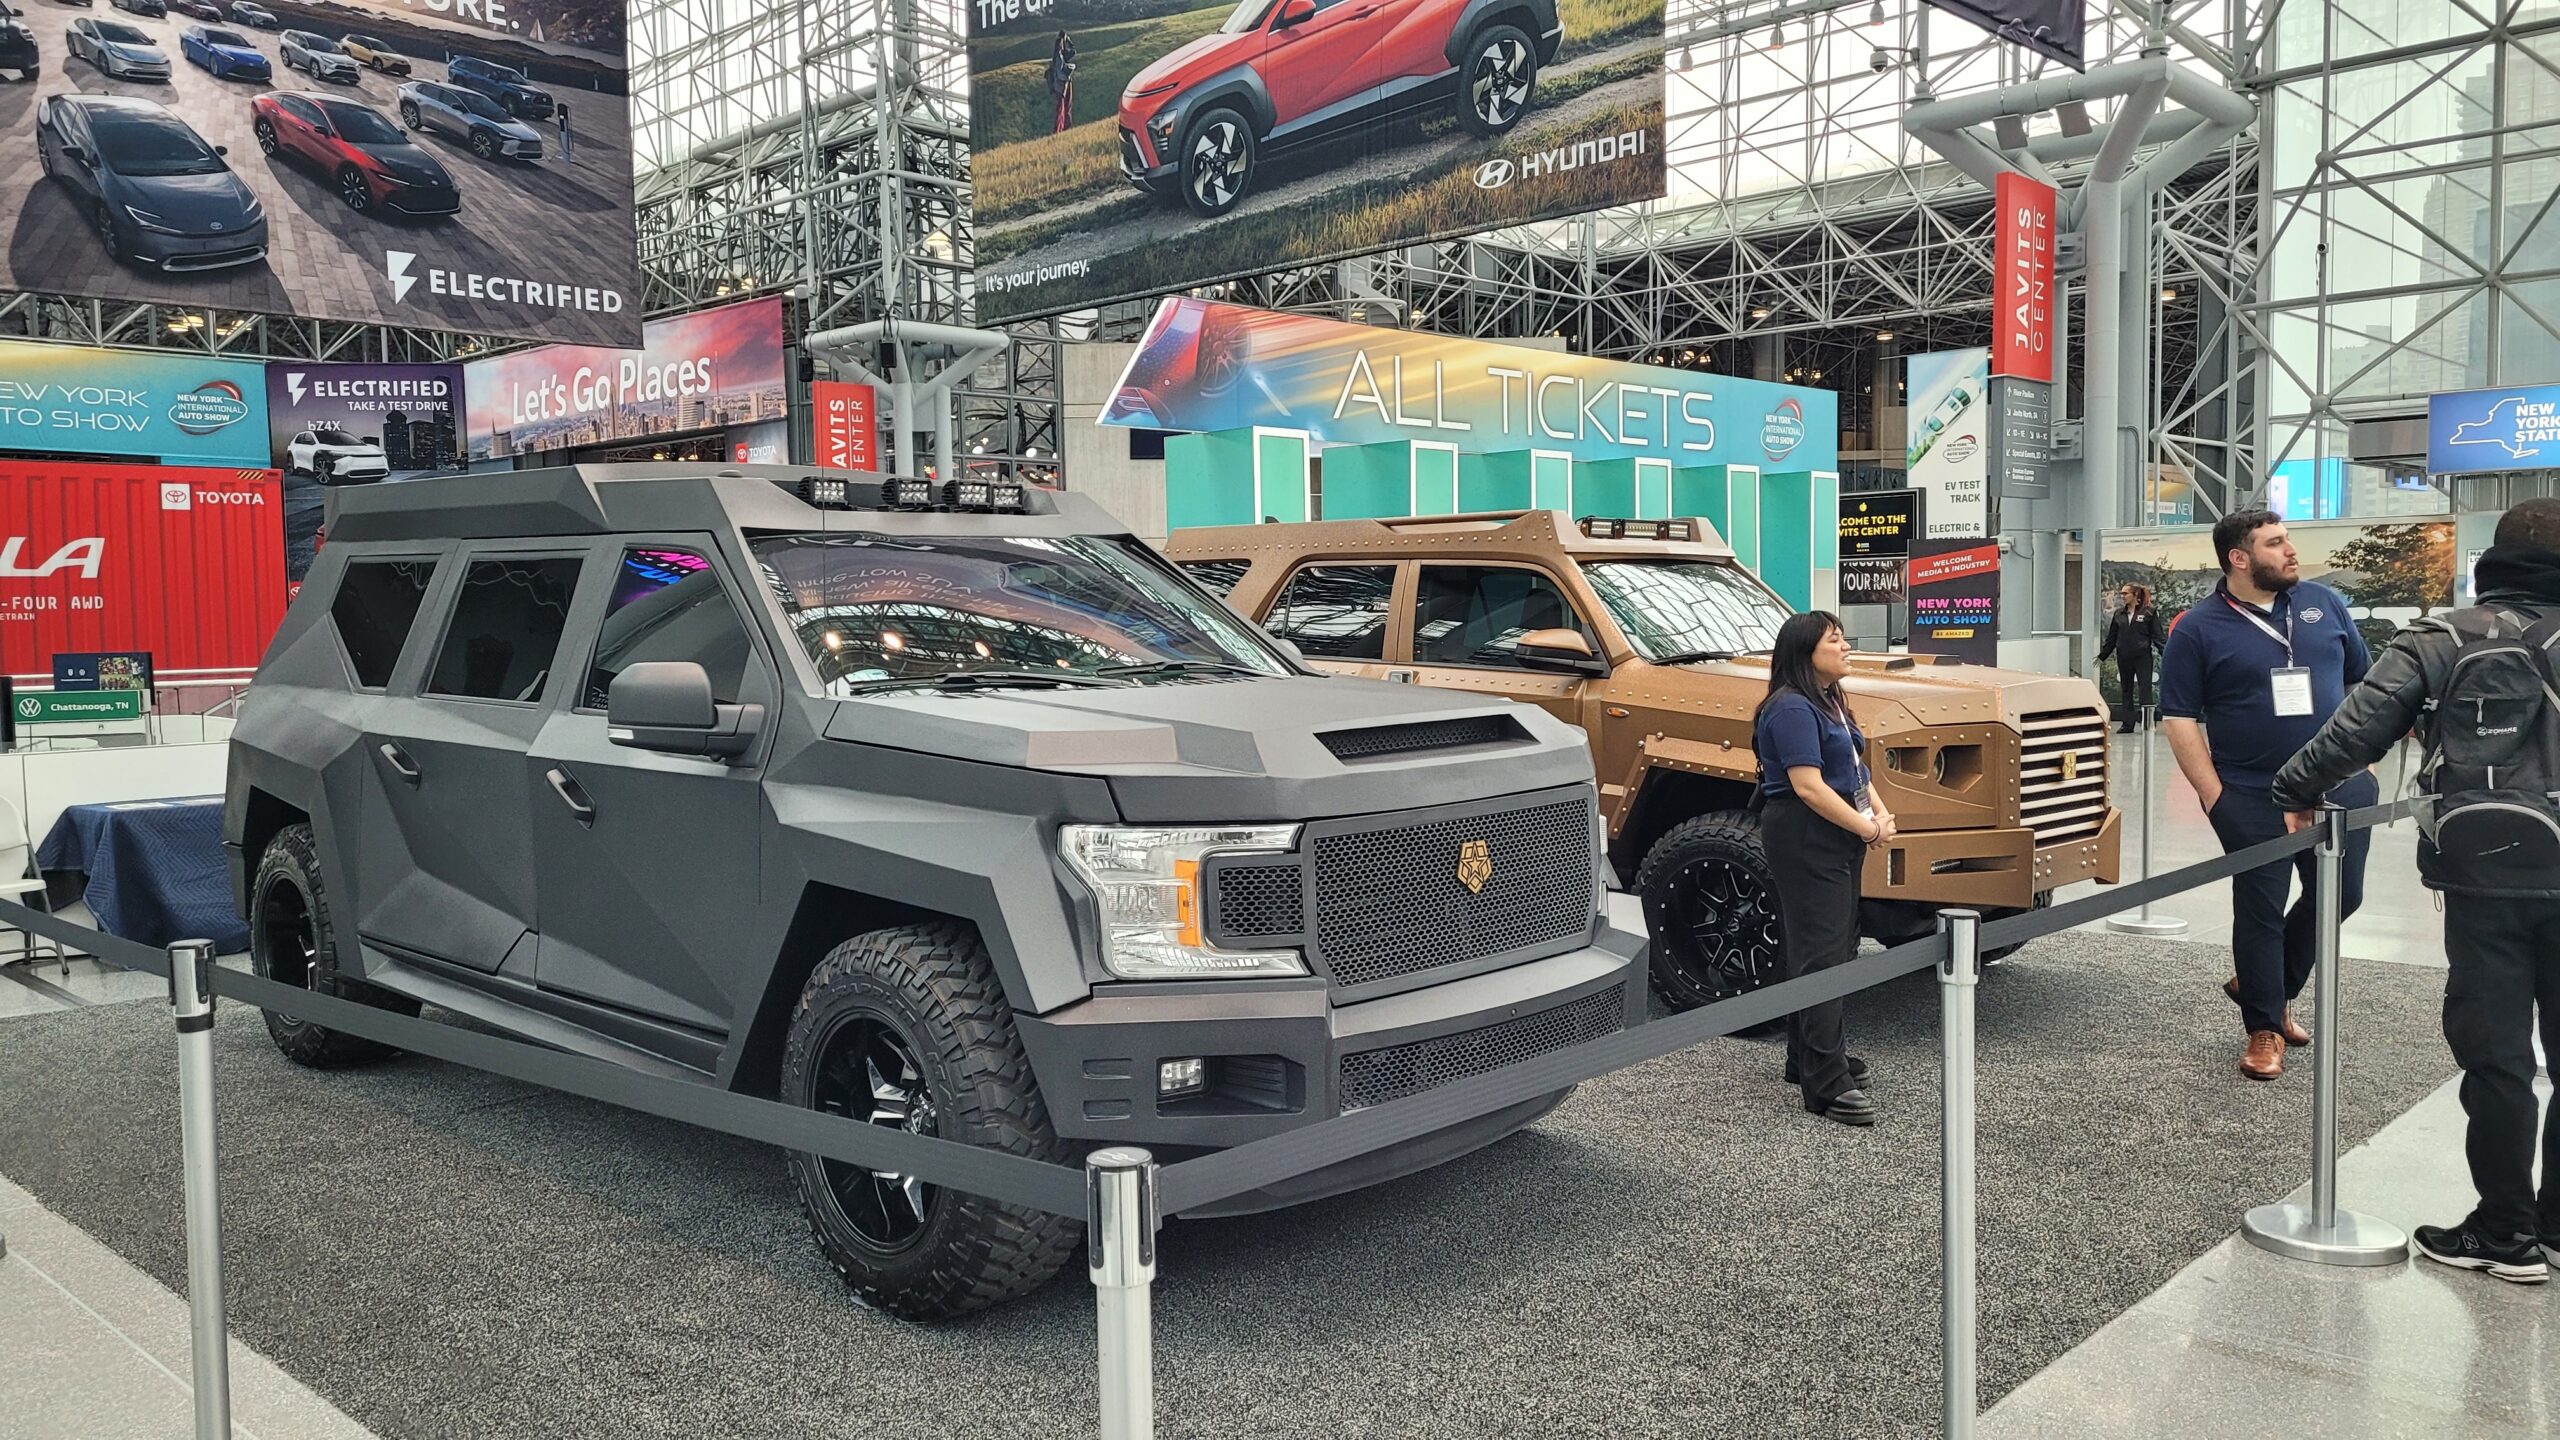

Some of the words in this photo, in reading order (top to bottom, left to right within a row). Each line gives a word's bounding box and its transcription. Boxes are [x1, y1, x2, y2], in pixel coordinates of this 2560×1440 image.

[404, 0, 519, 29] RE.
[976, 0, 1019, 29] The
[1522, 129, 1645, 179] HYUNDAI
[986, 274, 1003, 292] It's
[1005, 270, 1035, 292] your
[1036, 259, 1089, 286] journey.
[2015, 207, 2032, 349] JAVITS
[2033, 212, 2046, 352] CENTER
[429, 269, 622, 313] ELECTRIFIED
[314, 381, 447, 397] ELECTRIFIED
[513, 374, 566, 424] Let's
[573, 367, 611, 411] Go
[619, 355, 711, 404] Places
[57, 385, 149, 408] YORK
[177, 394, 198, 402] NEW
[200, 395, 223, 403] YORK
[1333, 349, 1471, 431] ALL
[1487, 367, 1714, 452] TICKETS
[177, 403, 243, 414] INTERNATIONAL
[348, 401, 375, 411] TAKE
[377, 401, 386, 411] A
[388, 401, 413, 411] TEST
[416, 401, 448, 411] DRIVE
[2516, 403, 2555, 417] NEW
[52, 411, 149, 432] SHOW
[178, 412, 202, 420] AUTO
[204, 413, 230, 421] SHOW
[1765, 414, 1777, 423] NEW
[1778, 416, 1791, 424] YORK
[308, 421, 341, 431] bZ4X
[2516, 417, 2560, 430] YORK
[830, 400, 847, 467] AVITS
[851, 401, 864, 471] ENTER
[1765, 425, 1801, 436] INTERNATIONAL
[2515, 429, 2560, 442] STAT
[1766, 435, 1779, 443] AUTO
[1780, 437, 1794, 445] SHOW
[748, 445, 776, 456] TOYOTA
[1945, 482, 1956, 490] EV
[1958, 480, 1981, 489] TEST
[196, 491, 264, 505] TOYOTA
[1950, 494, 1981, 503] TRACK
[1871, 516, 1885, 524] TO
[1887, 515, 1906, 523] THE
[1861, 526, 1899, 535] CENTER
[1929, 523, 1971, 533] ELECTRIC
[1973, 523, 1981, 531] &
[1933, 555, 1972, 567] WELCOME
[1918, 569, 1942, 578] MEDIA
[1952, 560, 1990, 571] INDUSTRY
[1873, 573, 1898, 590] RAV4
[71, 596, 104, 609] AWD
[1917, 599, 1949, 608] NEW
[1954, 598, 1991, 607] YORK
[1916, 616, 1949, 624] AUTO
[1953, 615, 1991, 624] SHOW
[50, 703, 114, 712] Chattanooga,
[116, 701, 129, 709] TN
